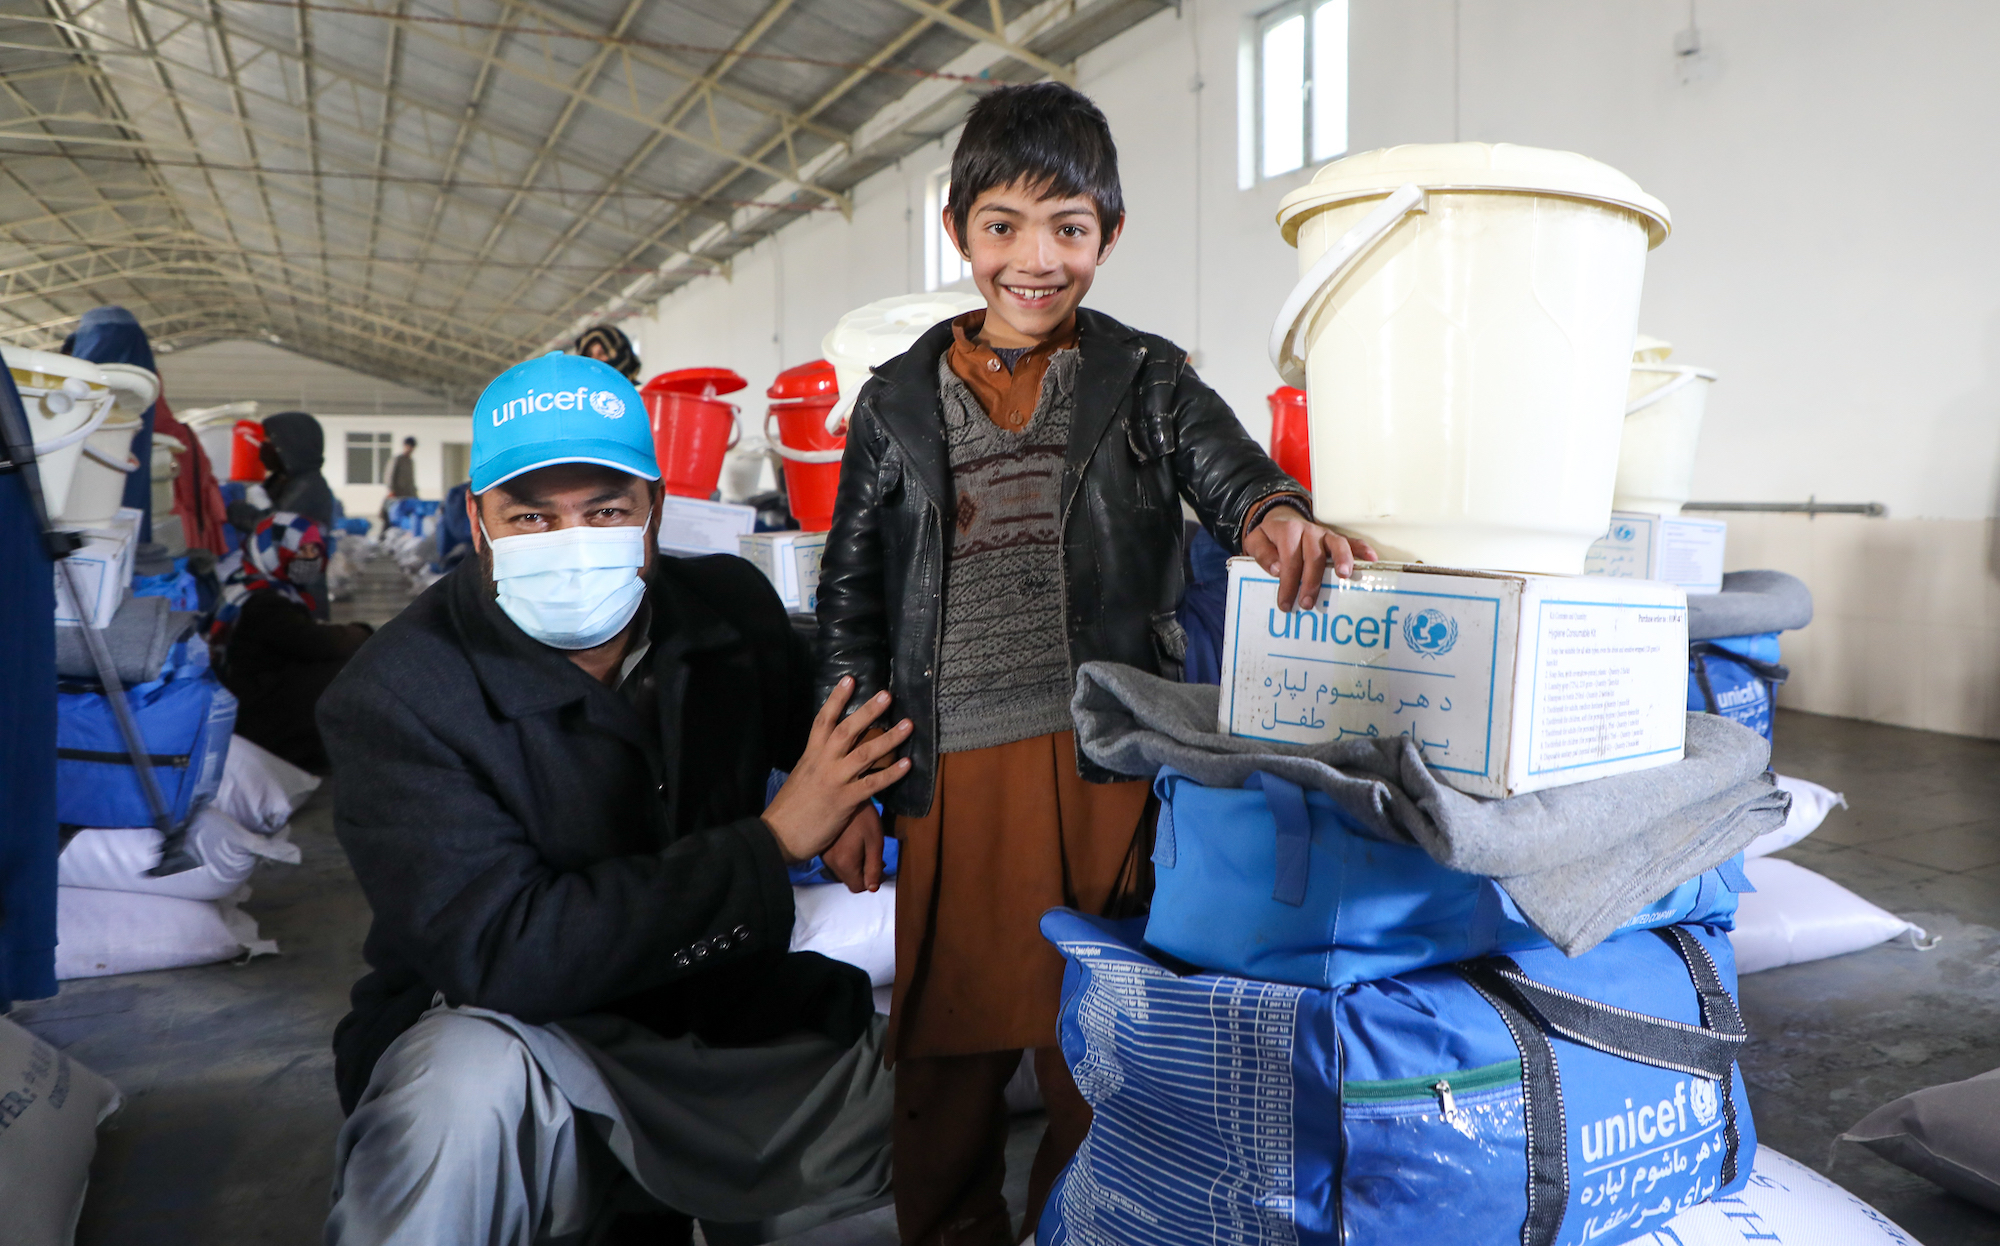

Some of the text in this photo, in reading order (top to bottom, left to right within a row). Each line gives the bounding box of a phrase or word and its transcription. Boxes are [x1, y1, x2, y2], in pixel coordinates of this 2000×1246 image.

[492, 387, 588, 427] unicef
[1268, 600, 1399, 650] unicef
[1548, 628, 1565, 640] Hygiene
[1566, 628, 1591, 638] Consumable
[1264, 668, 1452, 714] د هر ماشوم لپاره
[1717, 681, 1757, 709] unicef
[1261, 702, 1326, 731] طفل
[1333, 723, 1379, 742] هر
[1075, 946, 1101, 957] Description
[1269, 1001, 1281, 1009] per
[1282, 1000, 1291, 1009] kit
[1137, 1010, 1149, 1020] Girls
[1267, 1012, 1279, 1020] per
[1281, 1012, 1290, 1021] kit
[1266, 1025, 1278, 1033] per
[1279, 1025, 1289, 1034] kit
[1265, 1038, 1277, 1046] per
[1278, 1038, 1288, 1047] kit
[1279, 1088, 1288, 1097] kit
[1581, 1080, 1686, 1163] unicef
[1279, 1127, 1288, 1135] kit
[1278, 1140, 1288, 1148] kit
[1278, 1167, 1288, 1175] kit
[1581, 1132, 1721, 1207] د هر ماشوم لپاره
[1265, 1199, 1289, 1207] per kit
[1630, 1195, 1672, 1229] هر
